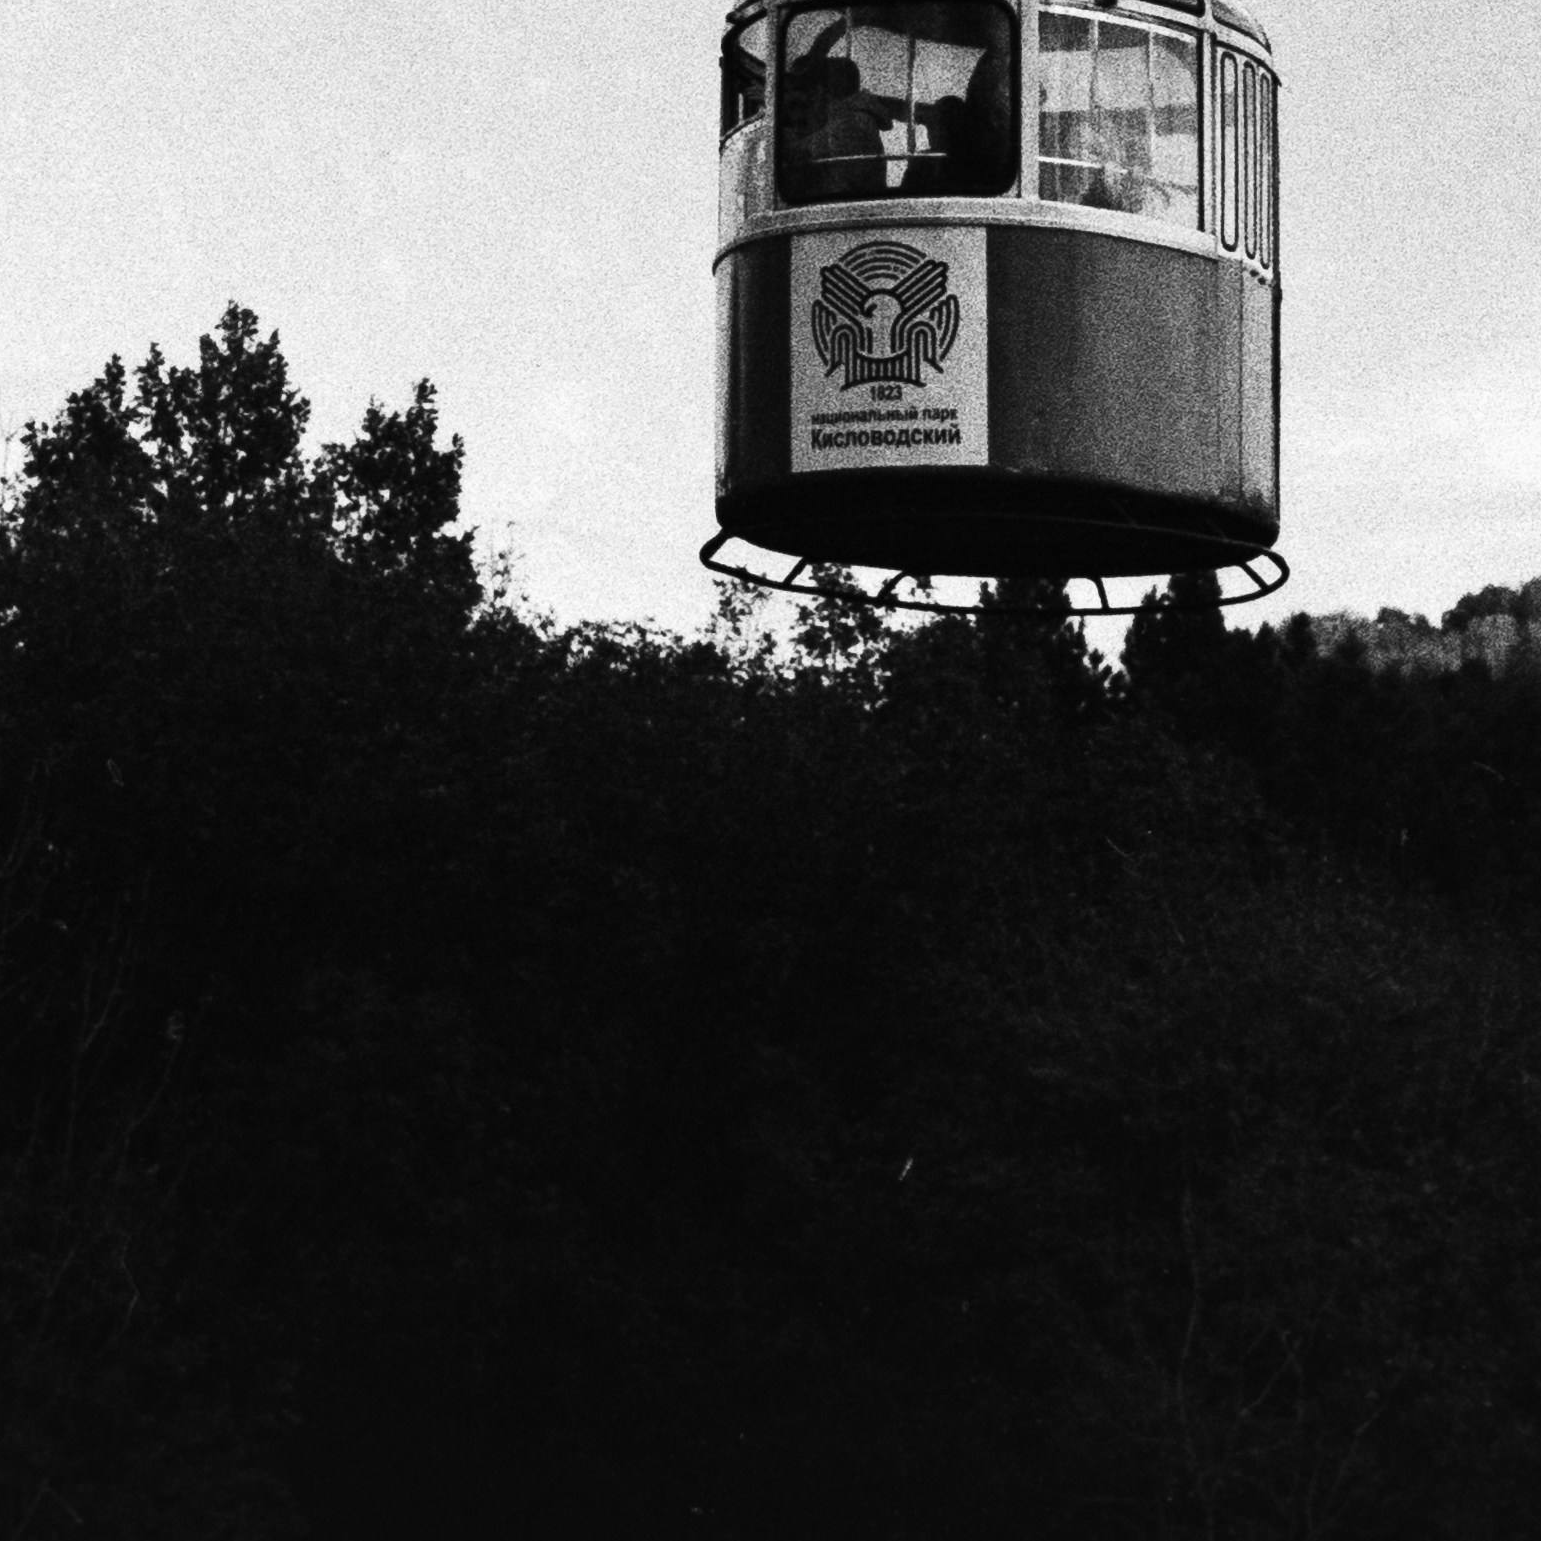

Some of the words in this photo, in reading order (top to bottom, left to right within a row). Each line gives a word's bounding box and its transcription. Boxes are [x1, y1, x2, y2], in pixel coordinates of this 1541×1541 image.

[870, 385, 903, 401] 1823
[811, 406, 919, 425] национальный
[922, 408, 959, 423] парк
[811, 423, 962, 450] Кисловодский
